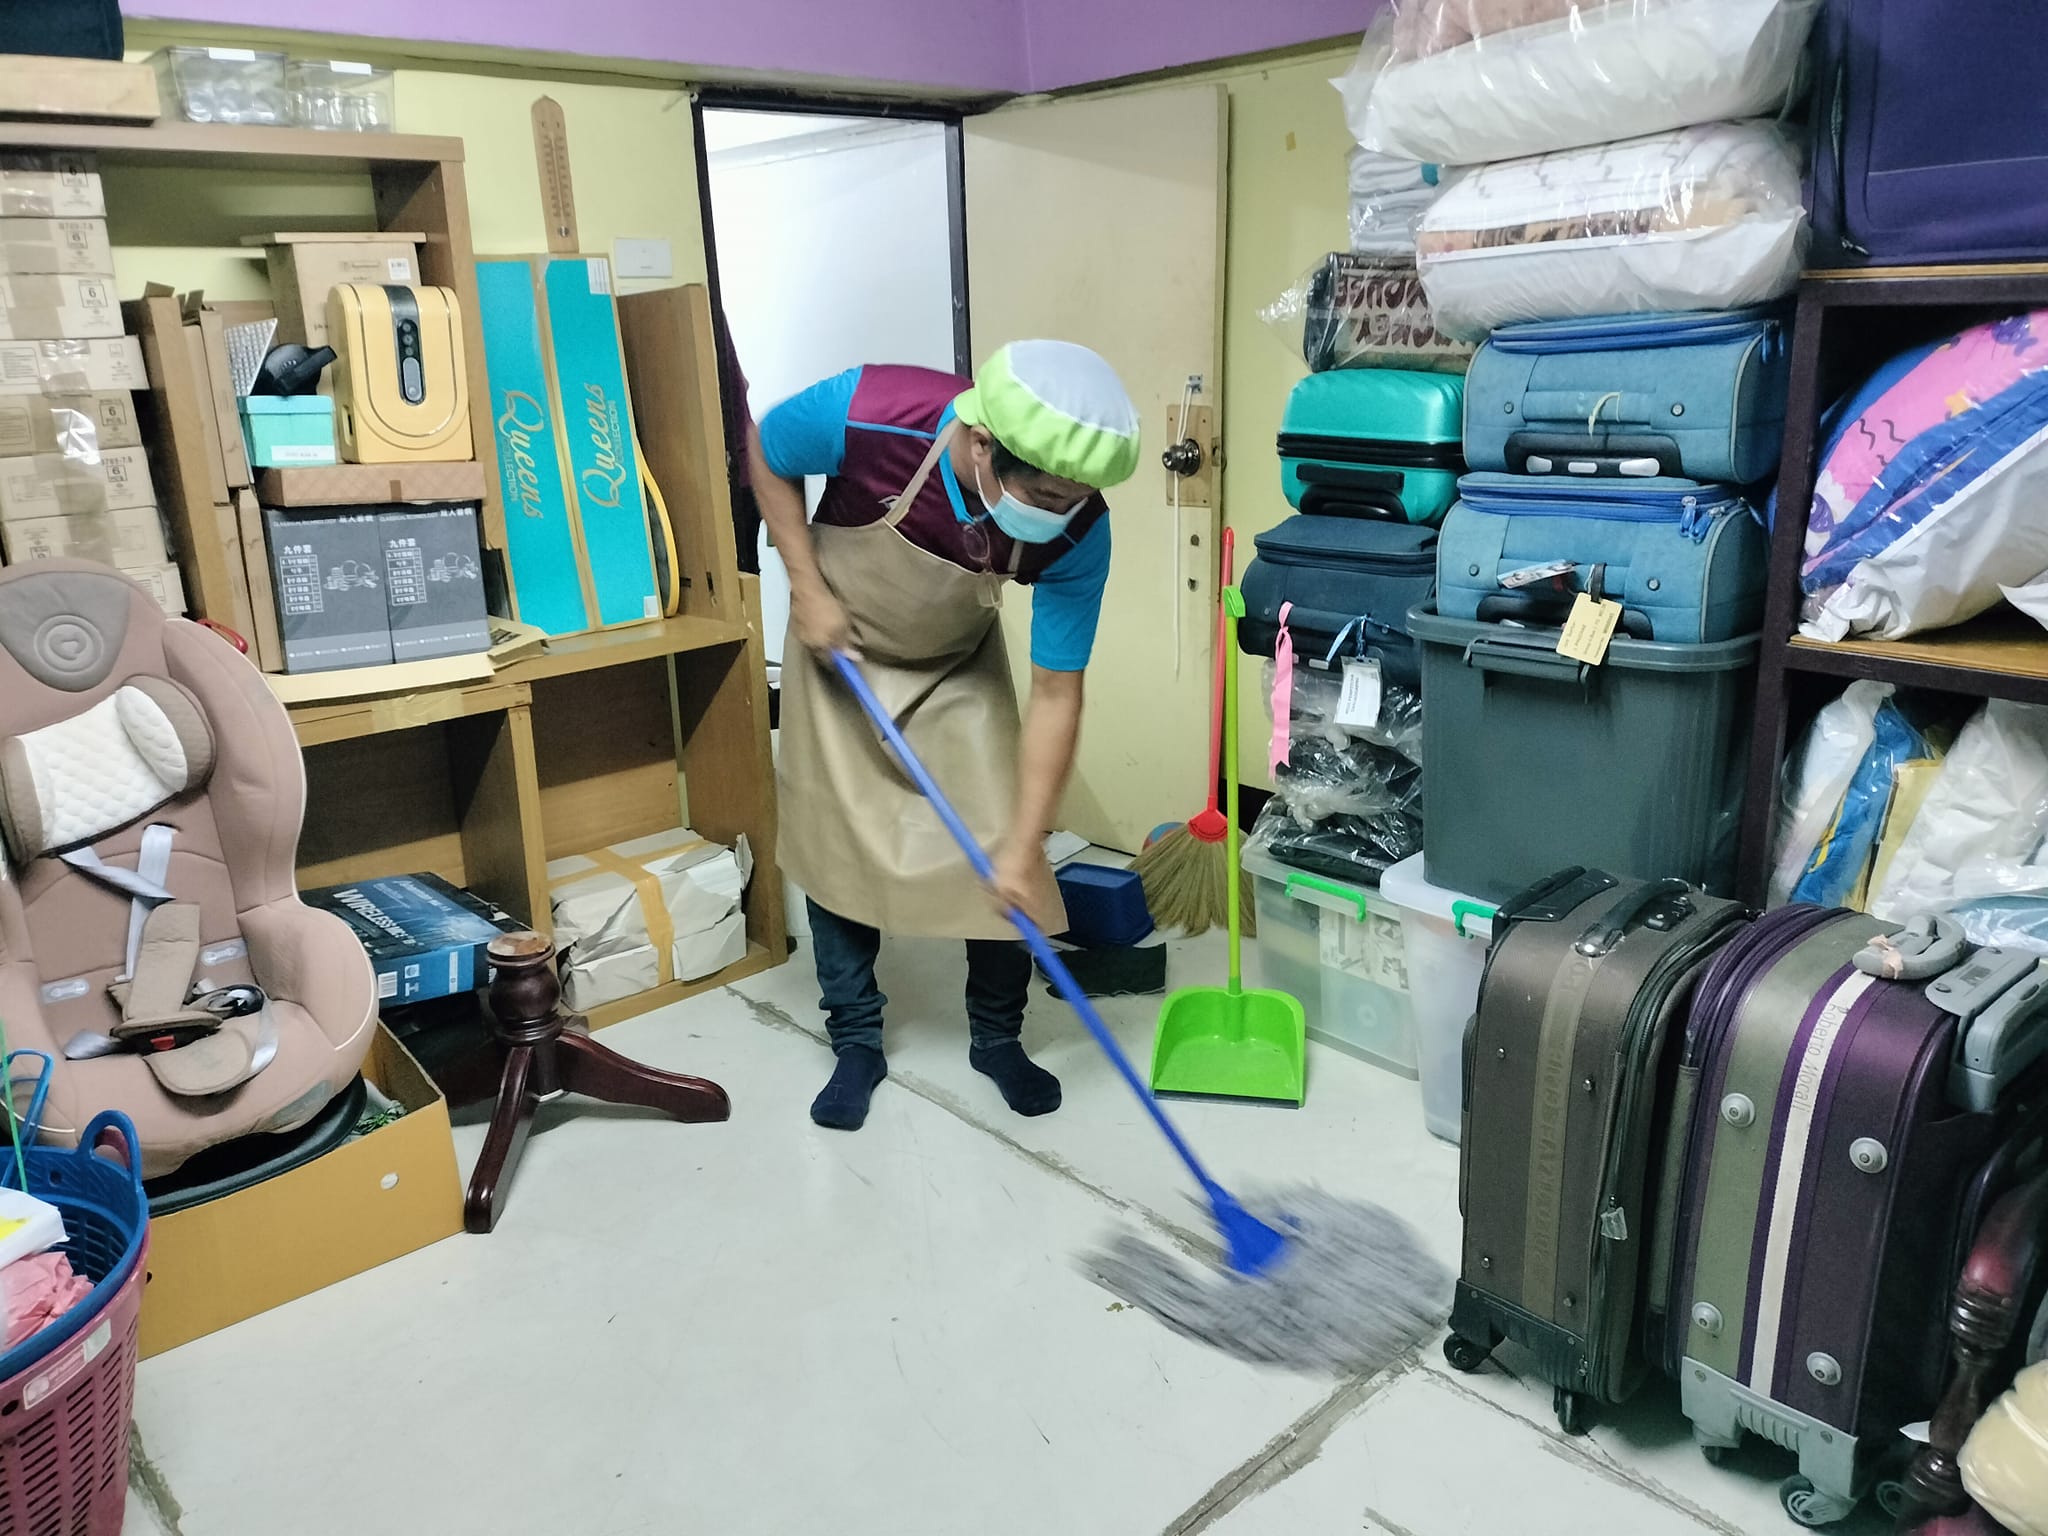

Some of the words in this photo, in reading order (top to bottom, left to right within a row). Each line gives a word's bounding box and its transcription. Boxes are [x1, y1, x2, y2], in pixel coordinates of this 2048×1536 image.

[88, 287, 97, 298] 6
[108, 406, 117, 416] 6
[112, 466, 121, 475] 6
[498, 389, 544, 519] Queens
[582, 382, 625, 508] Queens
[1808, 1003, 1849, 1056] Roberto
[1792, 1058, 1820, 1113] Mocali
